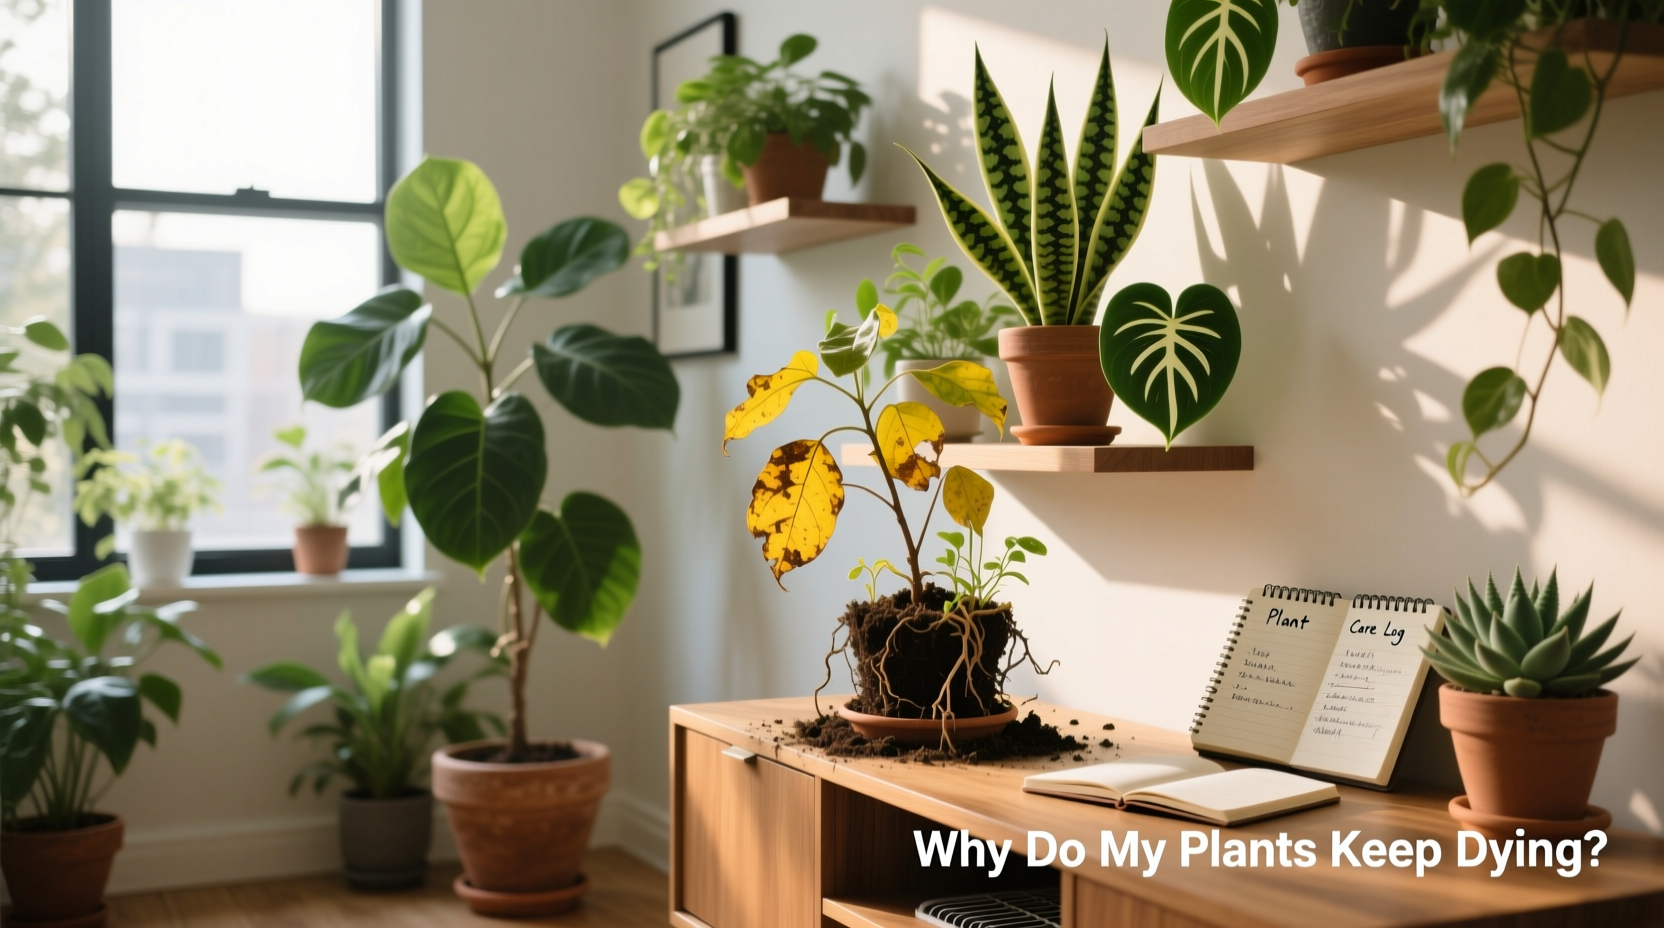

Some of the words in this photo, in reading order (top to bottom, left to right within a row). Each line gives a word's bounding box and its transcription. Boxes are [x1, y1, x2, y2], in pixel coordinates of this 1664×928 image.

[1266, 607, 1310, 630] Plant
[1349, 619, 1377, 635] Care
[1383, 620, 1405, 646] Log
